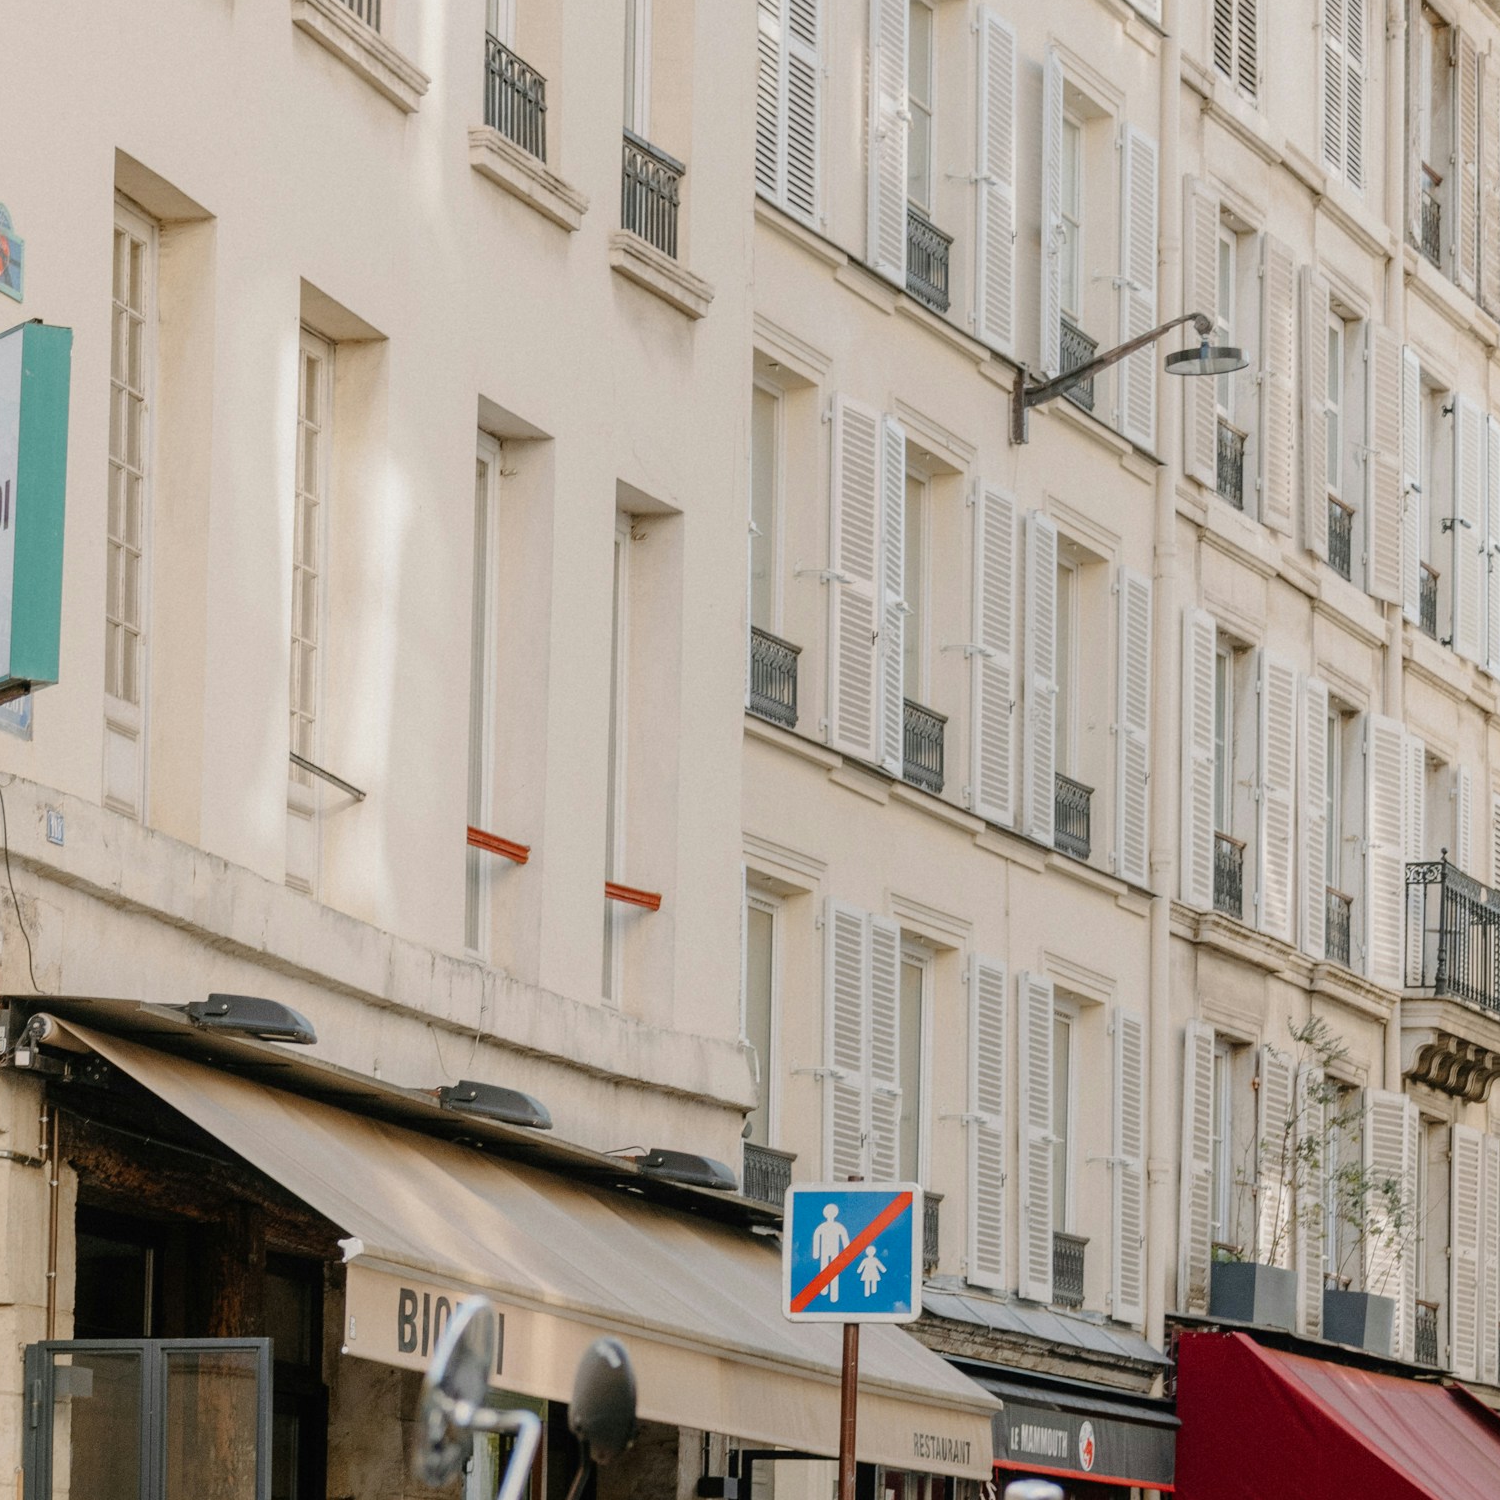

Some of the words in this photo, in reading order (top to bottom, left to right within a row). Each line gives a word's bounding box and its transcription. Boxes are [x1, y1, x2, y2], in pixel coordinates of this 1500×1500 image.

[398, 1287, 505, 1376] BIOI
[913, 1432, 971, 1466] RESTAURANT
[1010, 1426, 1019, 1451] LE
[1021, 1423, 1068, 1459] MAMMOUTH
